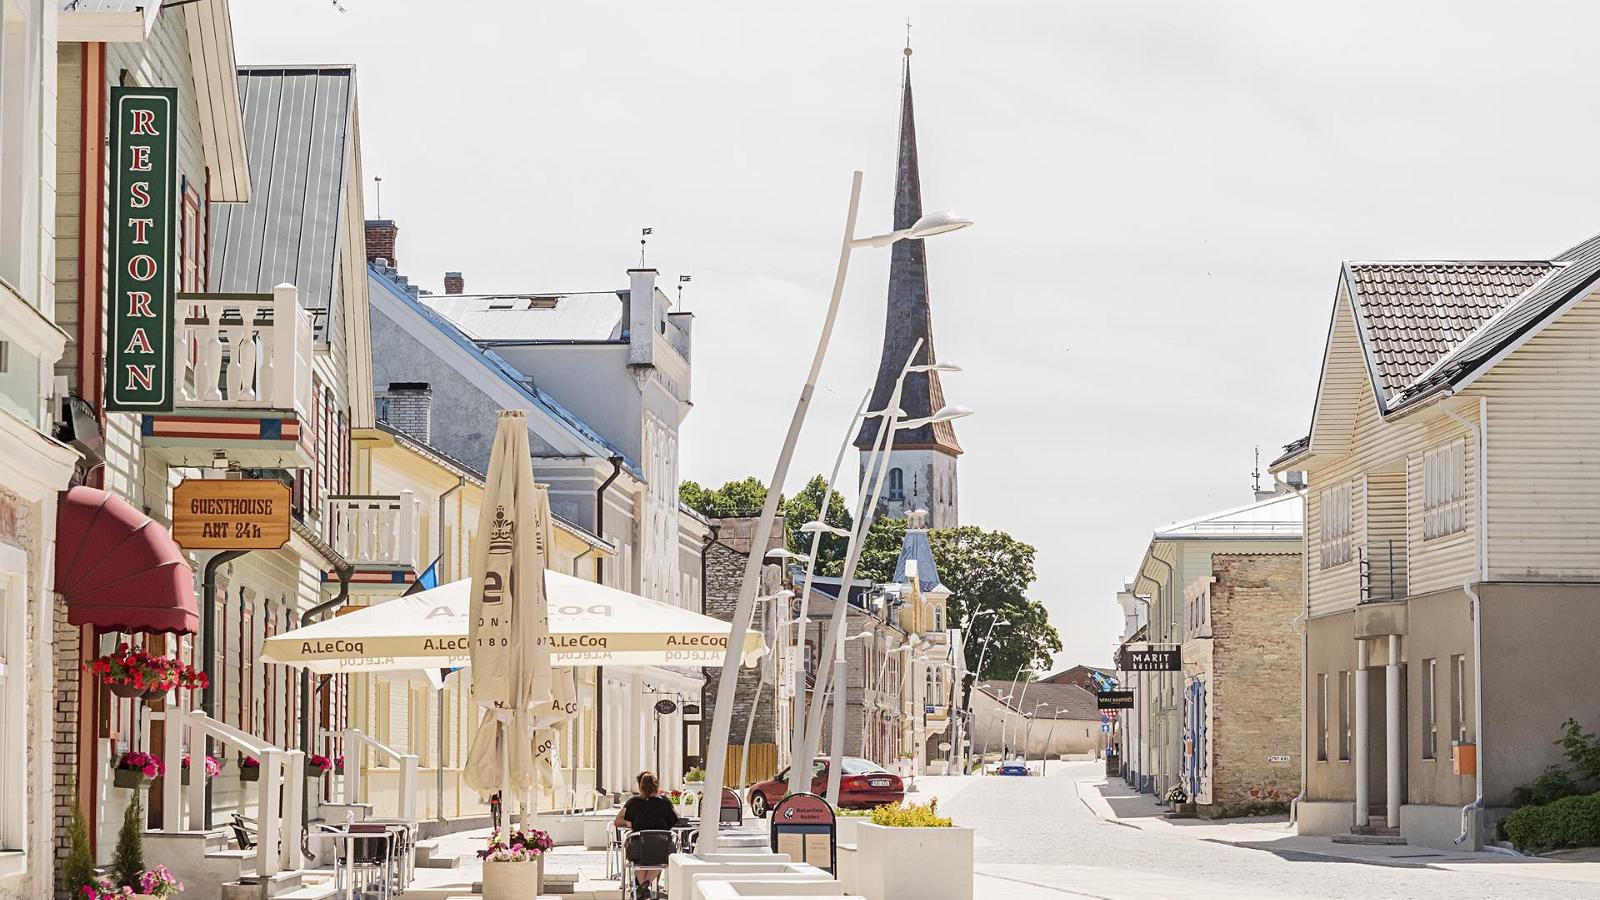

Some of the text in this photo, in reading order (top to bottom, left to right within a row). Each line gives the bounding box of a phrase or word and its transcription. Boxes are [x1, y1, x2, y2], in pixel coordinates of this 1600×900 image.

[124, 109, 160, 391] RESTORAN
[191, 499, 273, 515] GUESTHOUSE
[202, 522, 229, 538] ART
[301, 640, 364, 655] A.LeCoq
[1132, 653, 1170, 663] MARIT
